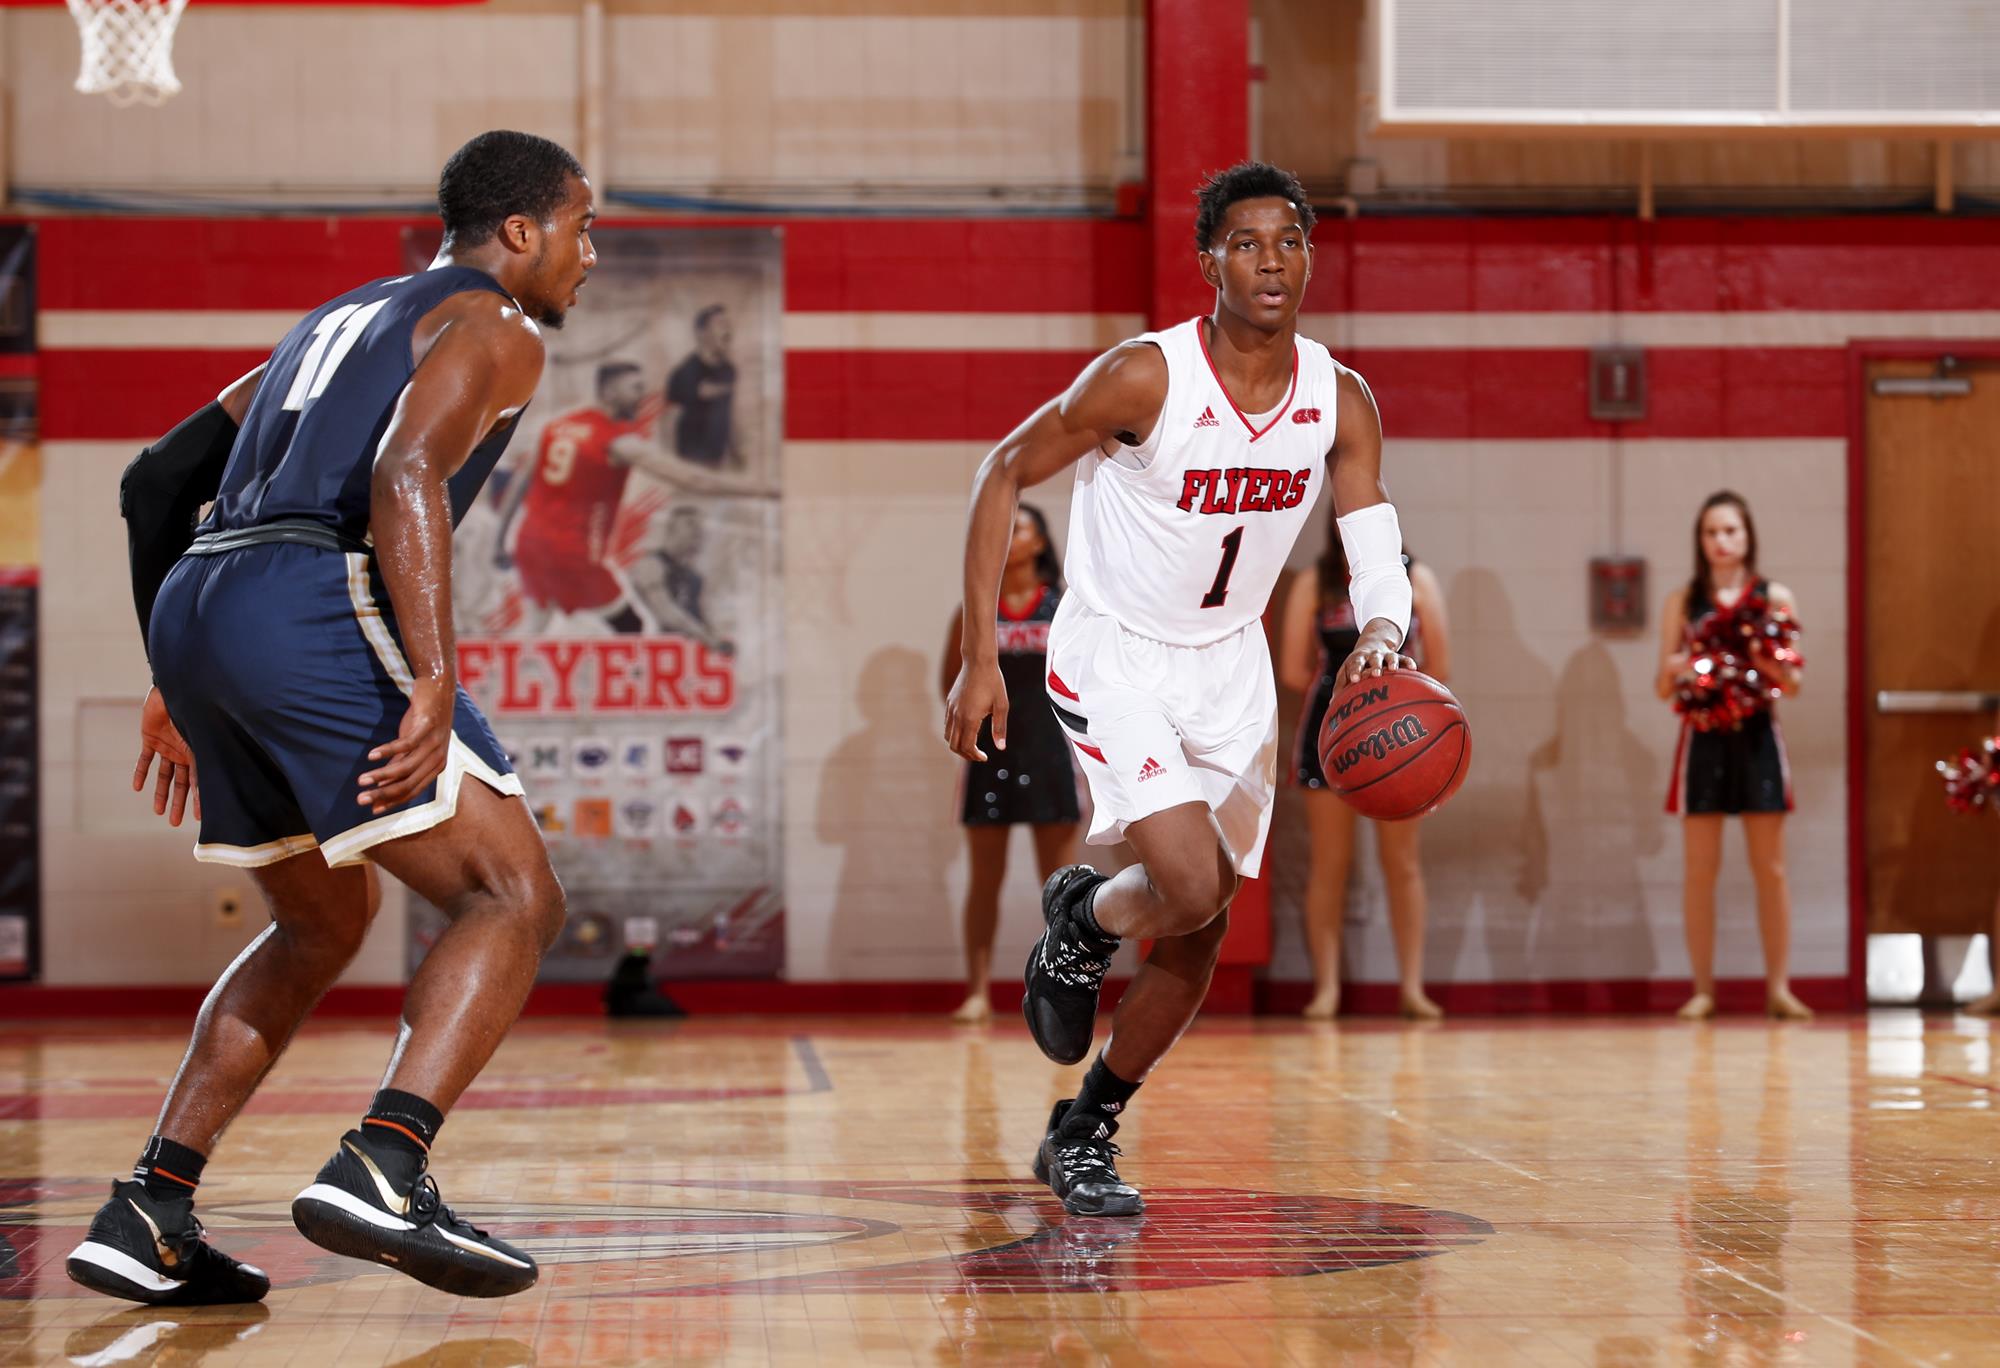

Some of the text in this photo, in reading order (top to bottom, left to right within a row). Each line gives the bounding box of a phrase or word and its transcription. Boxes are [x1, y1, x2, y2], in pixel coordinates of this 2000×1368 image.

[282, 296, 392, 411] 11
[542, 438, 578, 487] 9
[1176, 467, 1312, 515] FLYERS
[1200, 526, 1245, 608] 1
[456, 639, 736, 713] FLYERS
[1332, 714, 1429, 775] Wilson
[1137, 768, 1168, 783] adidas
